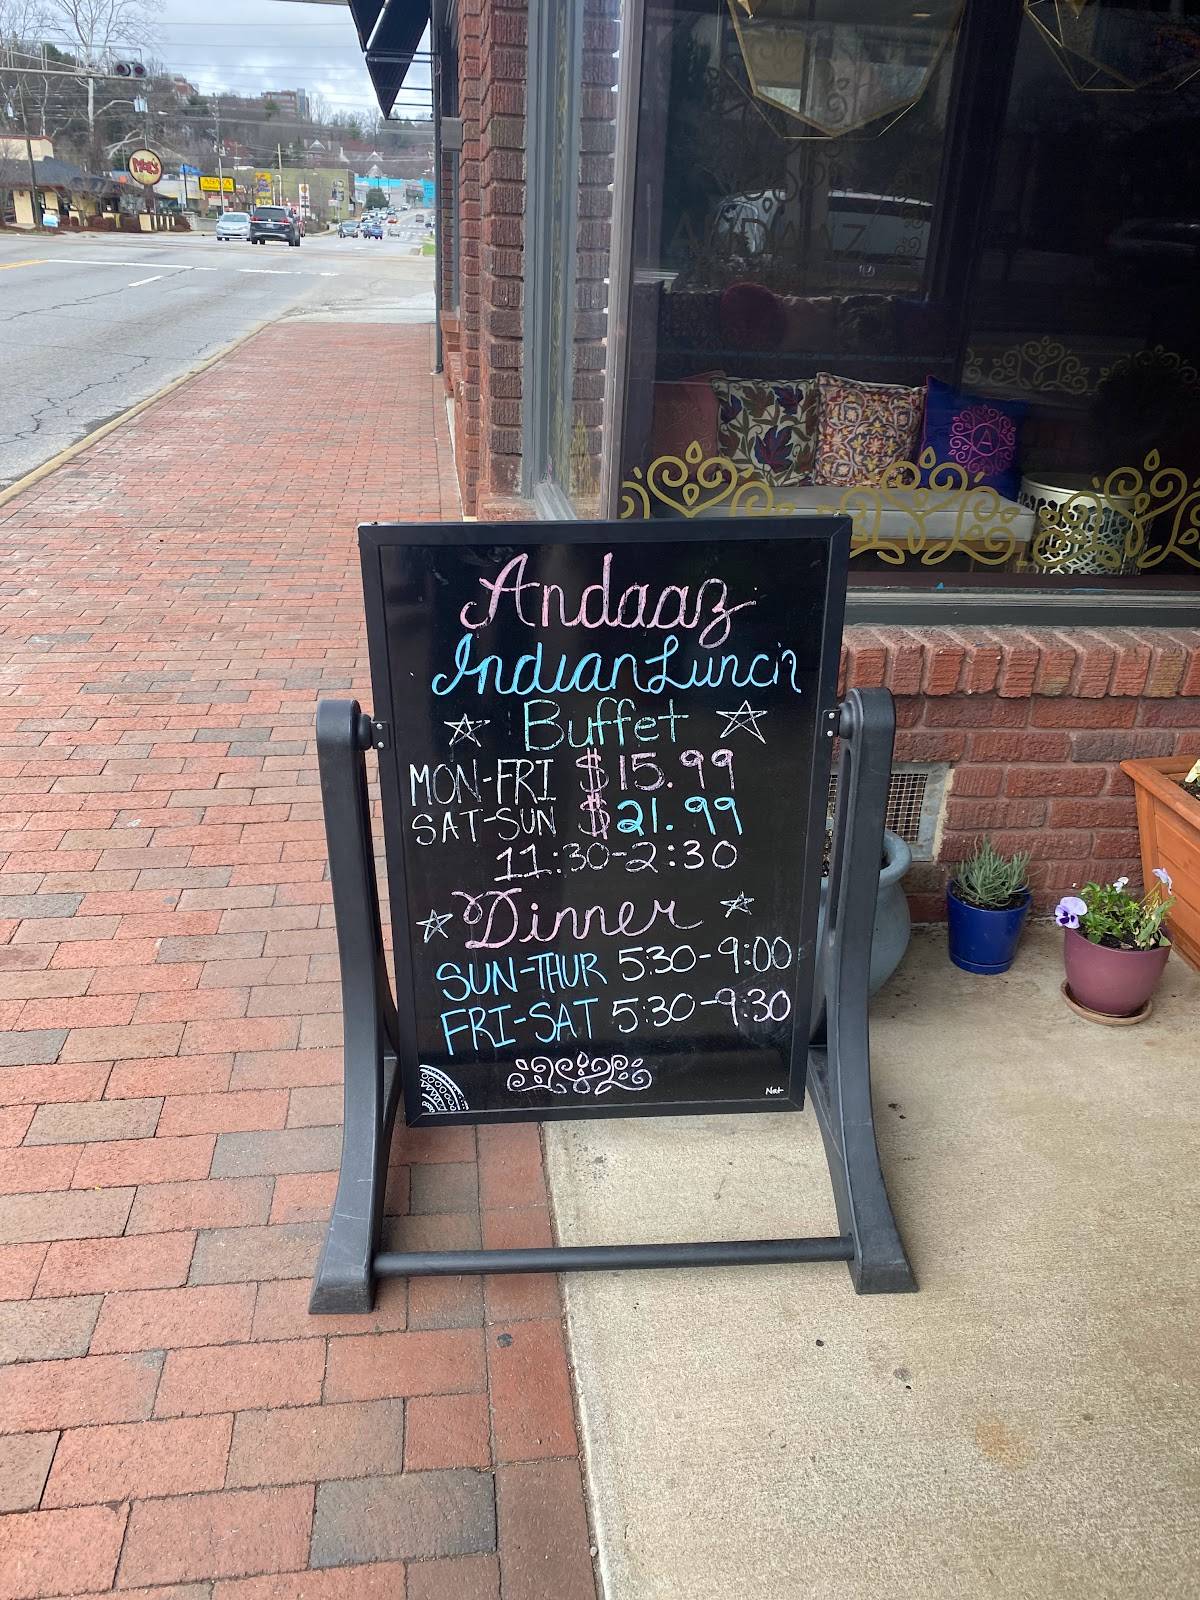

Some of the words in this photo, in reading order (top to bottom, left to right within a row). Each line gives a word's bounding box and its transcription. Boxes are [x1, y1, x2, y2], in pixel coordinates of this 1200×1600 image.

[460, 552, 757, 648] Andaaz
[431, 632, 649, 695] Indian
[524, 696, 690, 752] Buffet
[409, 758, 556, 806] MON-FRI
[575, 748, 736, 793] $15.99
[411, 806, 557, 846] SAT-SUN
[577, 792, 743, 840] $21.99
[494, 839, 738, 881] 11:30-2:30
[451, 887, 705, 950] Dinner
[436, 951, 608, 1001] SUN-THUR
[440, 998, 599, 1056] FRI-SAT
